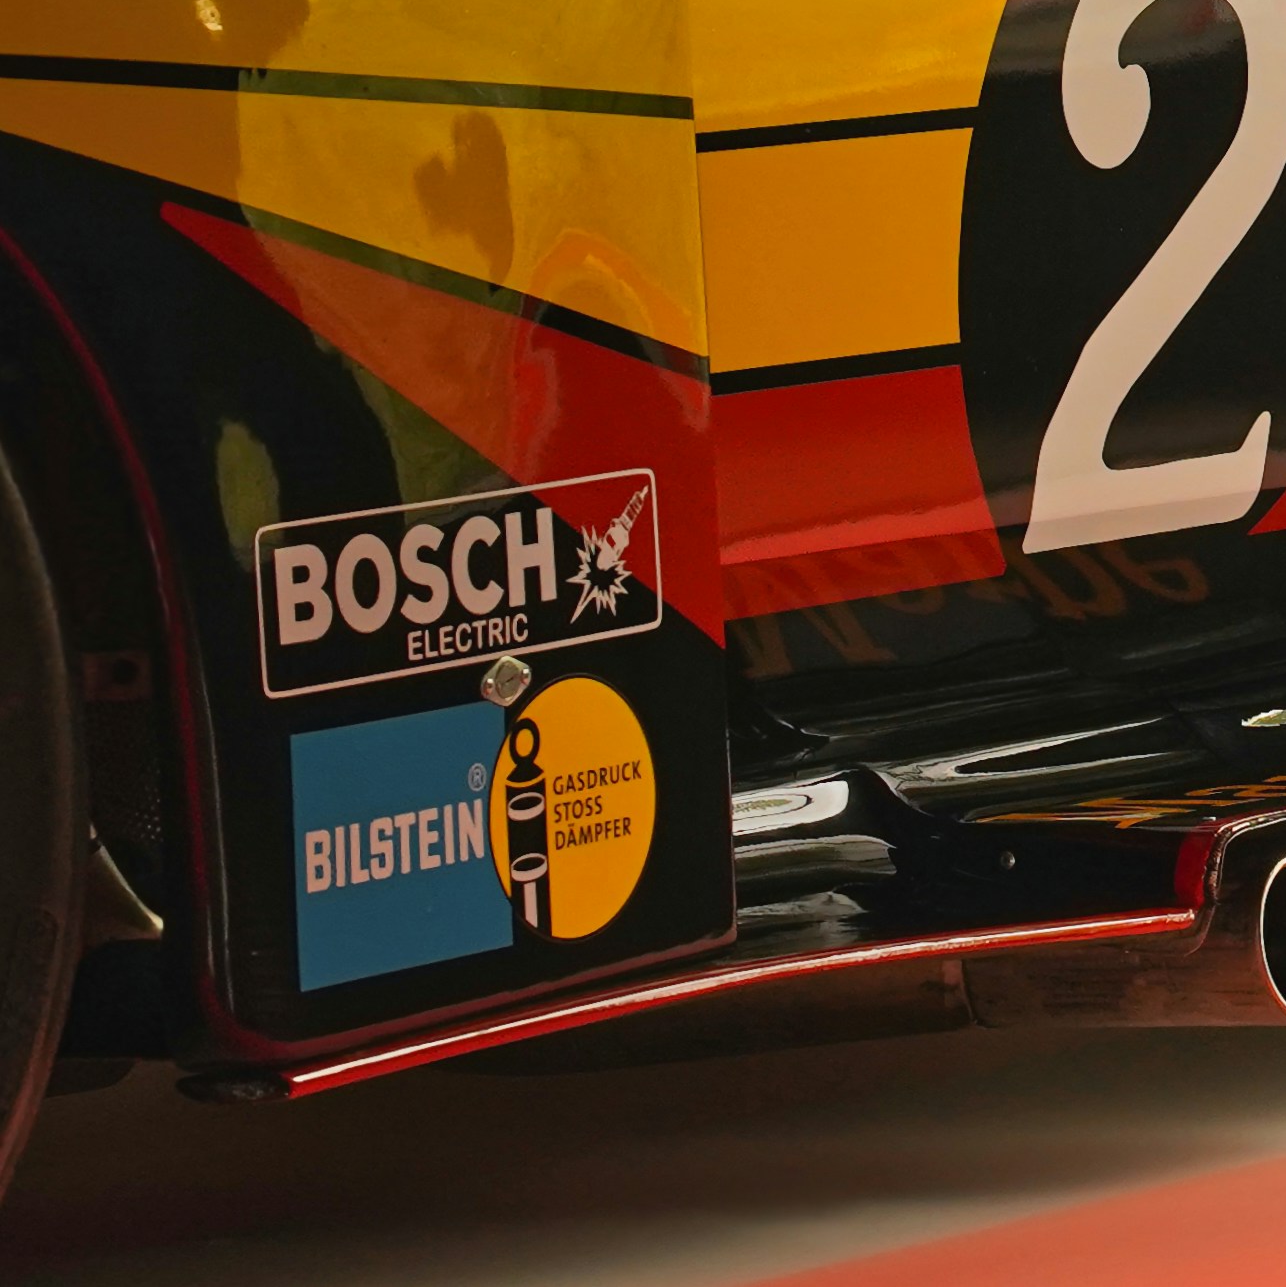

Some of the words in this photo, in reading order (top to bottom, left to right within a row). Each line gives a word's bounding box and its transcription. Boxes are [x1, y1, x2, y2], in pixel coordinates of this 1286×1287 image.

[274, 507, 558, 647] BOSCH
[407, 612, 530, 662] ELECTRIC
[552, 760, 642, 796] GASDRUCK
[553, 795, 603, 825] STOSS
[304, 797, 485, 895] BILSTEIN
[554, 815, 632, 851] DÄMPFER
